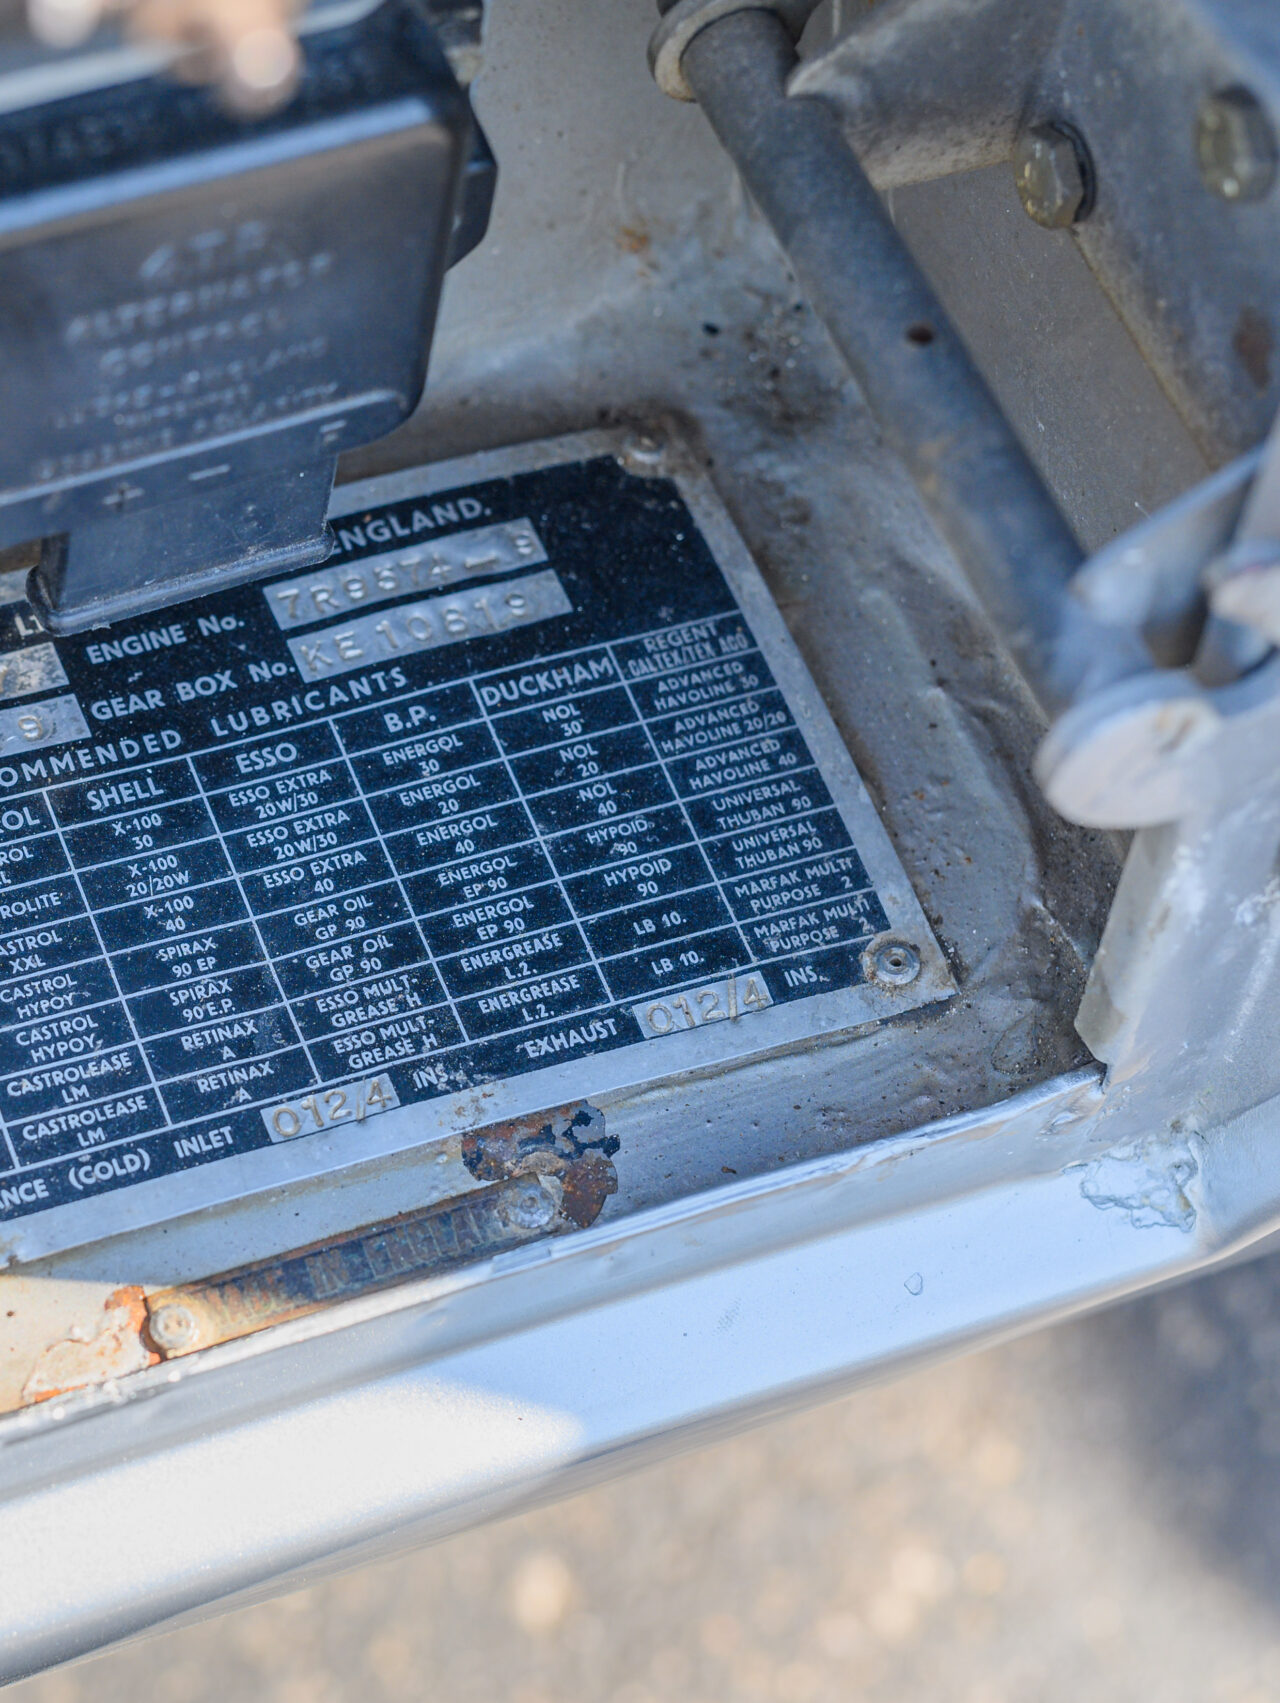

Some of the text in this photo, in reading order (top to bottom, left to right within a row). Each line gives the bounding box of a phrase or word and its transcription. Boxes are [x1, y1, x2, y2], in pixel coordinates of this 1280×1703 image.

[333, 497, 492, 553] NGLAND.
[14, 614, 45, 636] LT
[86, 624, 186, 664] ENGINE
[197, 615, 244, 636] No.
[642, 622, 716, 652] REGENT
[90, 689, 165, 719] GEAR
[175, 670, 237, 701] BOX
[248, 660, 295, 682] No.
[480, 656, 613, 706] DUCKHAM
[658, 661, 743, 692] ADVANCED
[210, 666, 407, 736] LUBRICANTS
[653, 680, 735, 710] HAVOLINE
[383, 705, 436, 732] B.P.
[542, 703, 580, 722] NOL
[674, 699, 759, 733] ADVANCED
[560, 720, 581, 736] 30
[660, 710, 786, 752] HAVOLINE 20/20
[235, 742, 296, 773] ESSO
[382, 733, 463, 765] ENERGOL
[558, 742, 598, 762] NOL
[695, 738, 780, 771] ADVANCED
[418, 758, 439, 776] 30
[576, 761, 598, 777] 20
[688, 758, 770, 789] HAVOLINE
[86, 777, 164, 811] SHELL
[228, 769, 331, 806] ESSO EXTRA
[399, 773, 480, 806] ENERGOL
[578, 781, 617, 801] NOL
[711, 779, 800, 810] UNIVERSAL
[437, 798, 459, 814] 20
[597, 799, 617, 815] 40
[716, 802, 785, 829] THUBAN
[111, 812, 162, 836] X-100
[246, 809, 350, 847] ESSO EXTRA
[416, 814, 497, 846] ENERGOL
[731, 820, 816, 851] UNIVERSAL
[131, 834, 153, 850] 30
[455, 838, 474, 853] 40
[734, 842, 800, 868] THUBAN
[127, 854, 177, 877] X-100
[262, 850, 367, 888] ESSO EXTRA
[437, 855, 517, 886] ENERGOL
[603, 858, 671, 886] HYPOID
[124, 870, 193, 901] 20/20W
[314, 878, 334, 893] 40
[462, 876, 507, 898] EP 90
[636, 880, 658, 896] 90
[734, 870, 801, 897] MARFAK
[749, 883, 821, 913] PURPOSE
[143, 895, 194, 918] X-100
[293, 895, 373, 926] GEAR OIL
[452, 895, 534, 927] ENERGOL
[165, 916, 185, 931] 40
[315, 915, 365, 939] GP 90
[476, 917, 525, 940] EP 90
[632, 918, 655, 935] LB
[753, 912, 819, 938] MARFAK
[157, 936, 216, 961] SPIRAX
[305, 933, 393, 970] GEAR OIL
[460, 932, 562, 971] ENERGREASE
[769, 925, 839, 952] PURPOSE
[8, 954, 46, 973] XXL
[329, 957, 381, 981] GP 90
[651, 957, 673, 975] LB
[0, 973, 77, 1002] CASTROL
[169, 978, 232, 1005] SPIRAX
[316, 990, 358, 1012] ESSO
[478, 974, 580, 1013] ENERGREASE
[16, 992, 74, 1018] HYPOY
[330, 998, 398, 1027] GREASE
[15, 1014, 98, 1045] CASTROL
[180, 1019, 258, 1050] RETINAX
[332, 1030, 375, 1053] ESSO
[30, 1033, 99, 1063] HYPOY
[348, 1039, 415, 1068] GREASE
[6, 1051, 131, 1096] CASTROLEASE
[195, 1061, 274, 1093] RETINAX
[61, 1084, 89, 1103] LM
[68, 1148, 150, 1189] (COLD)
[173, 1125, 233, 1158] INLET
[521, 1018, 617, 1058] EXHAUST
[22, 1095, 147, 1140] CASTROLEASE
[76, 1127, 105, 1146] LM
